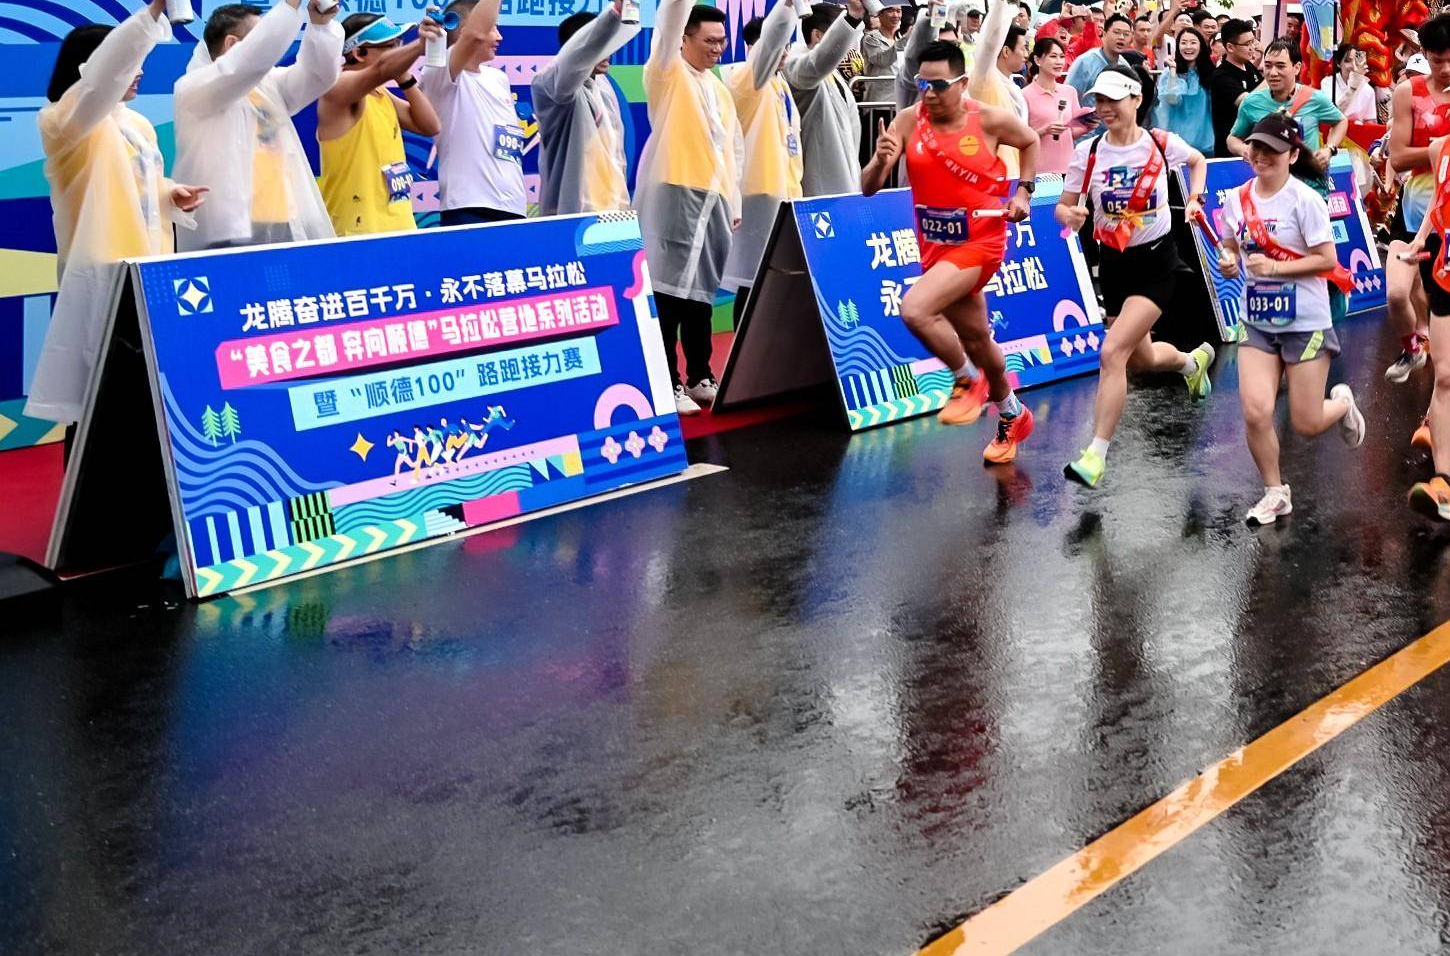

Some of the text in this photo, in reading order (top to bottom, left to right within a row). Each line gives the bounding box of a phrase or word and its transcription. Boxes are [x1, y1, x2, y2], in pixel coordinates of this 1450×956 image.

[499, 134, 523, 151] 090-
[922, 217, 962, 235] 022-01
[1250, 296, 1289, 312] 033-01
